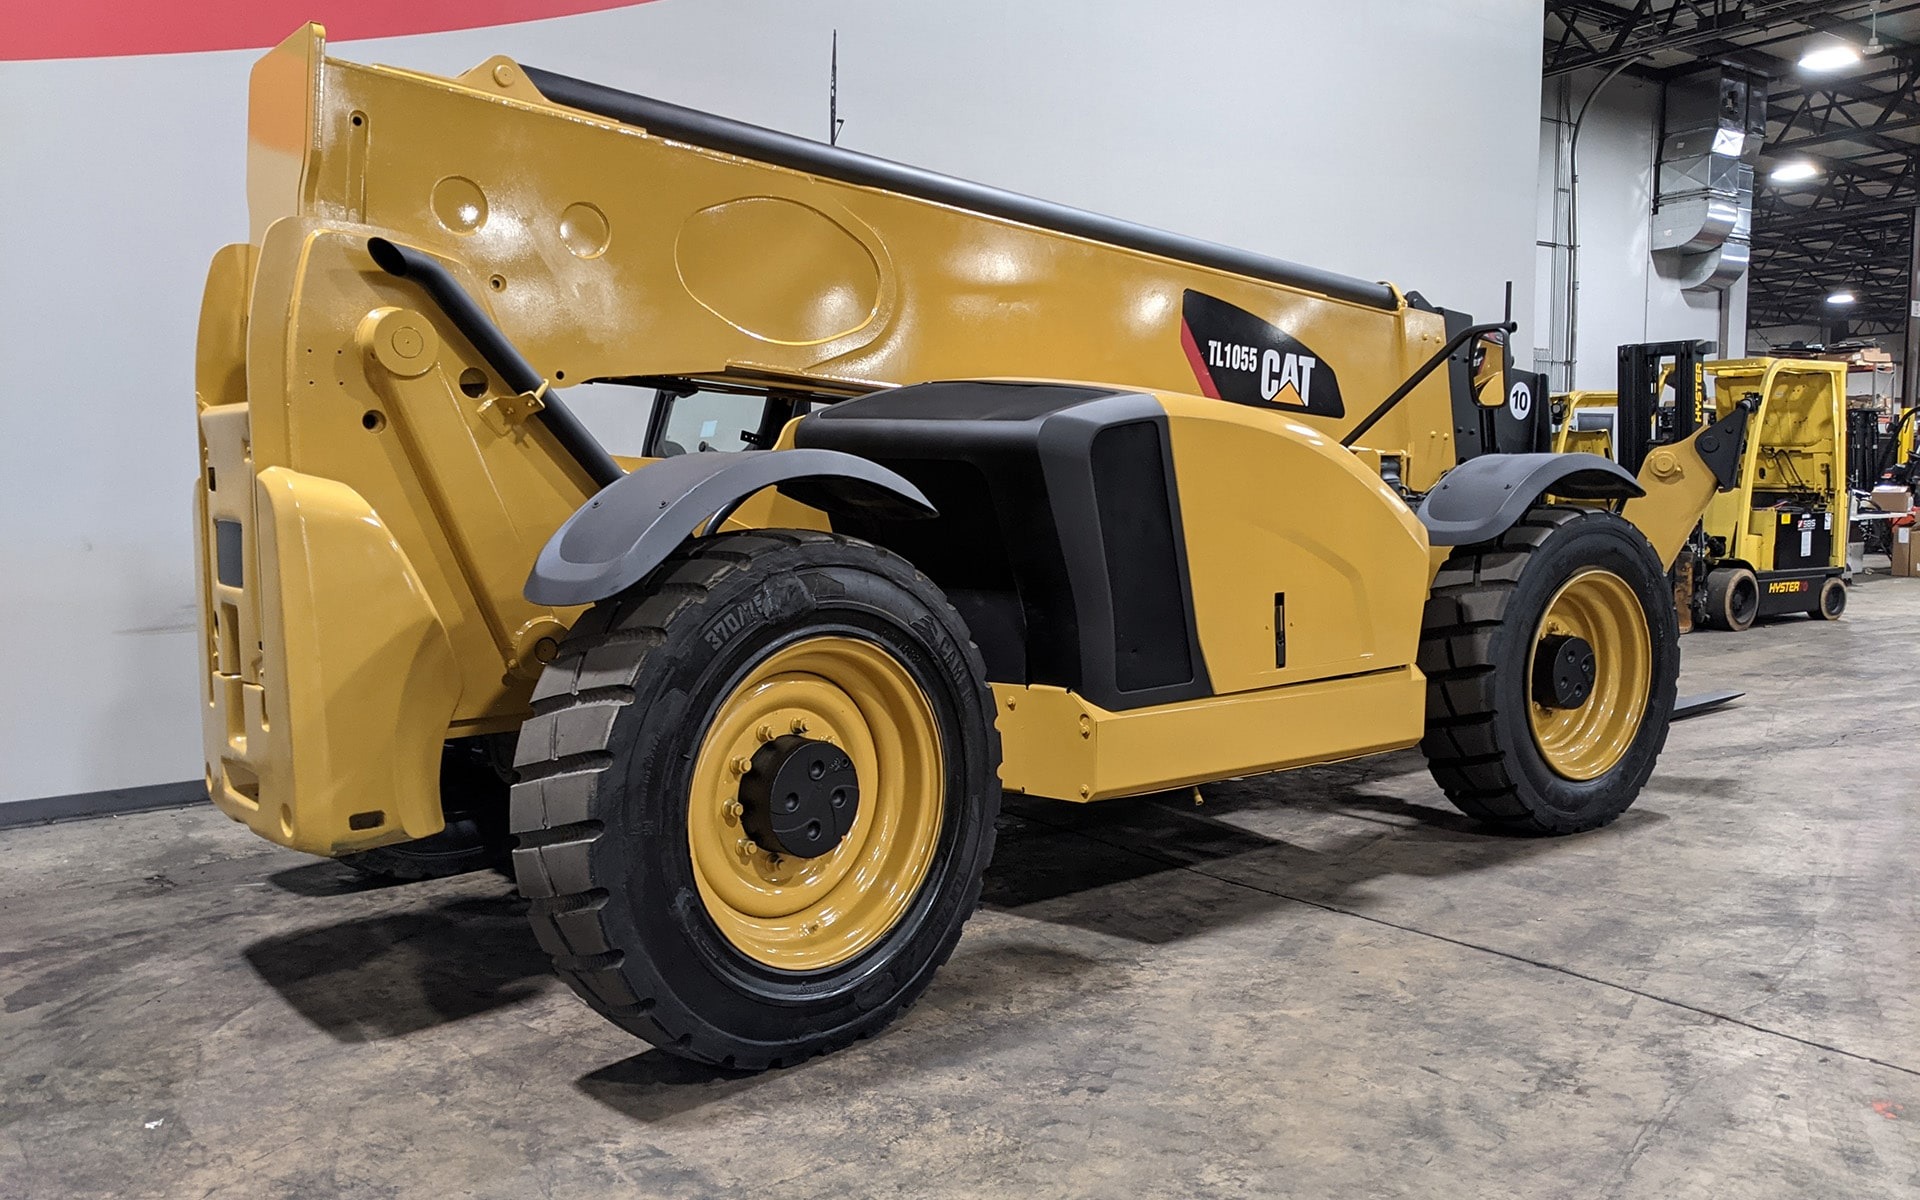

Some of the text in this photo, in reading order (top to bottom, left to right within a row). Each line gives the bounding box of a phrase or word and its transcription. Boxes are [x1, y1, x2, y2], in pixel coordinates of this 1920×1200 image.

[1208, 339, 1316, 407] TL1055 CAT
[1695, 362, 1703, 423] HYSTER
[1512, 390, 1528, 411] 10
[1768, 581, 1800, 594] HYSTER
